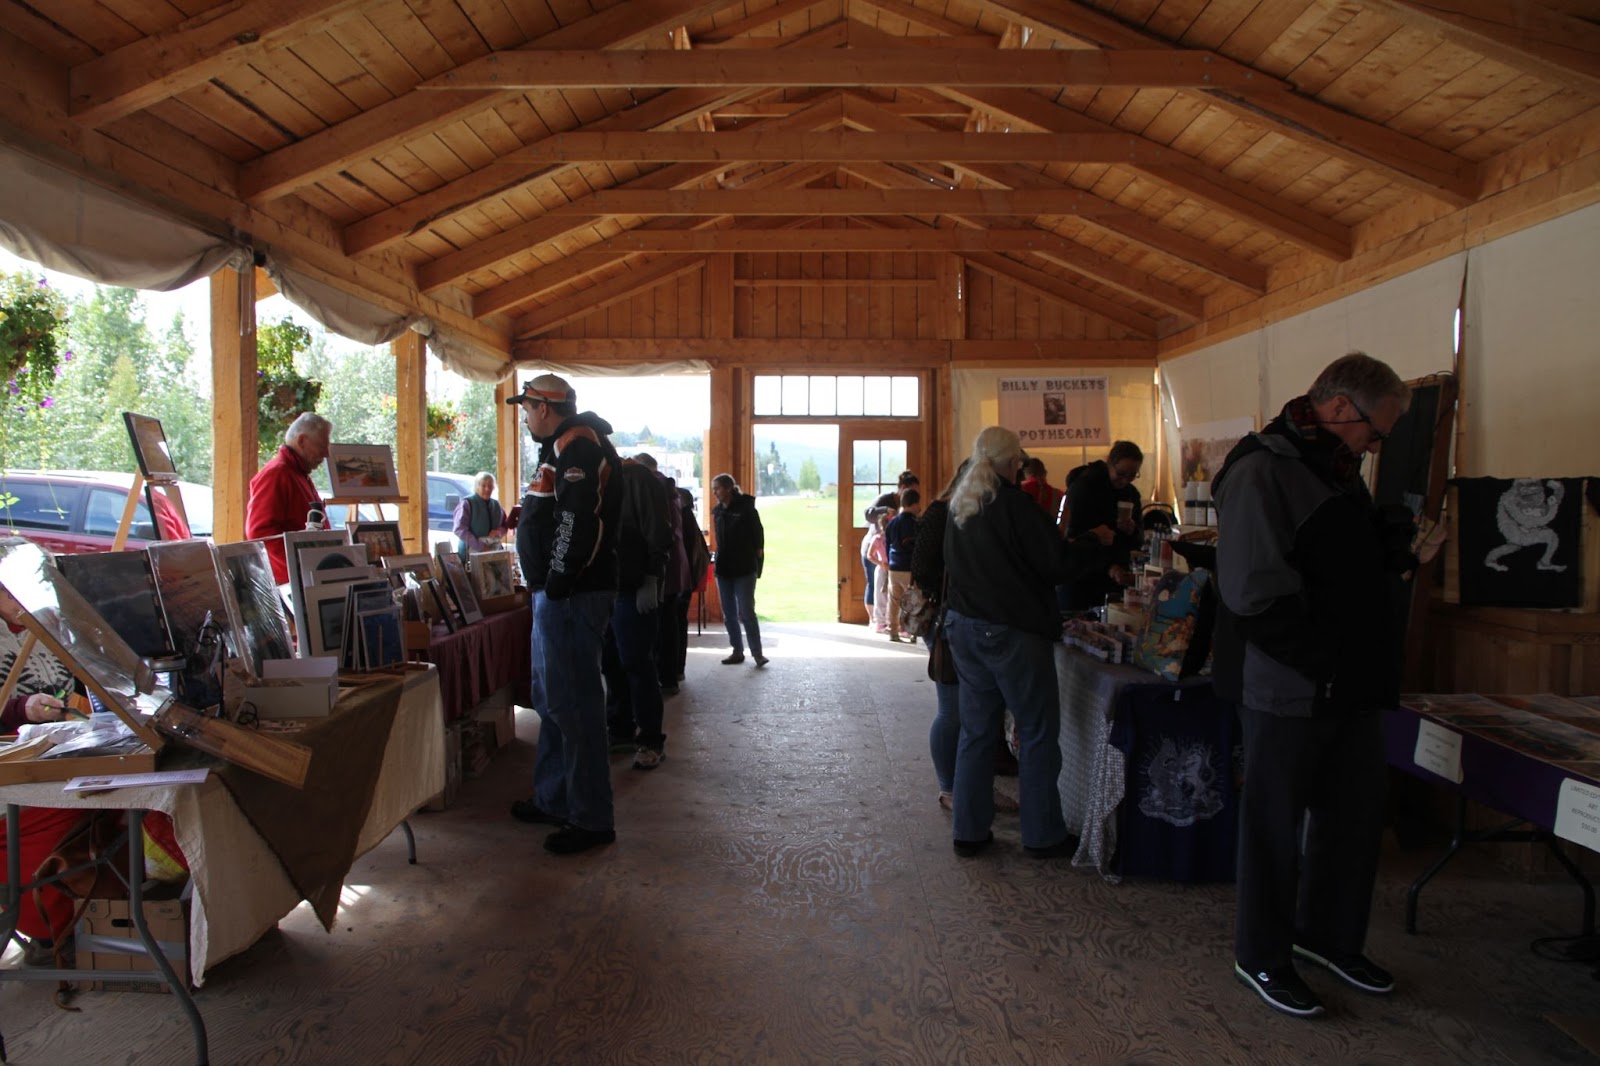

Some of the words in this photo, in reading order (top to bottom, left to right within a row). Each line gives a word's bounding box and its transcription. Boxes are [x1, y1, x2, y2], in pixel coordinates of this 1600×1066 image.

[1001, 381, 1038, 391] BILLY
[1046, 380, 1105, 390] BUCKETS
[1019, 428, 1101, 440] POTHECARY
